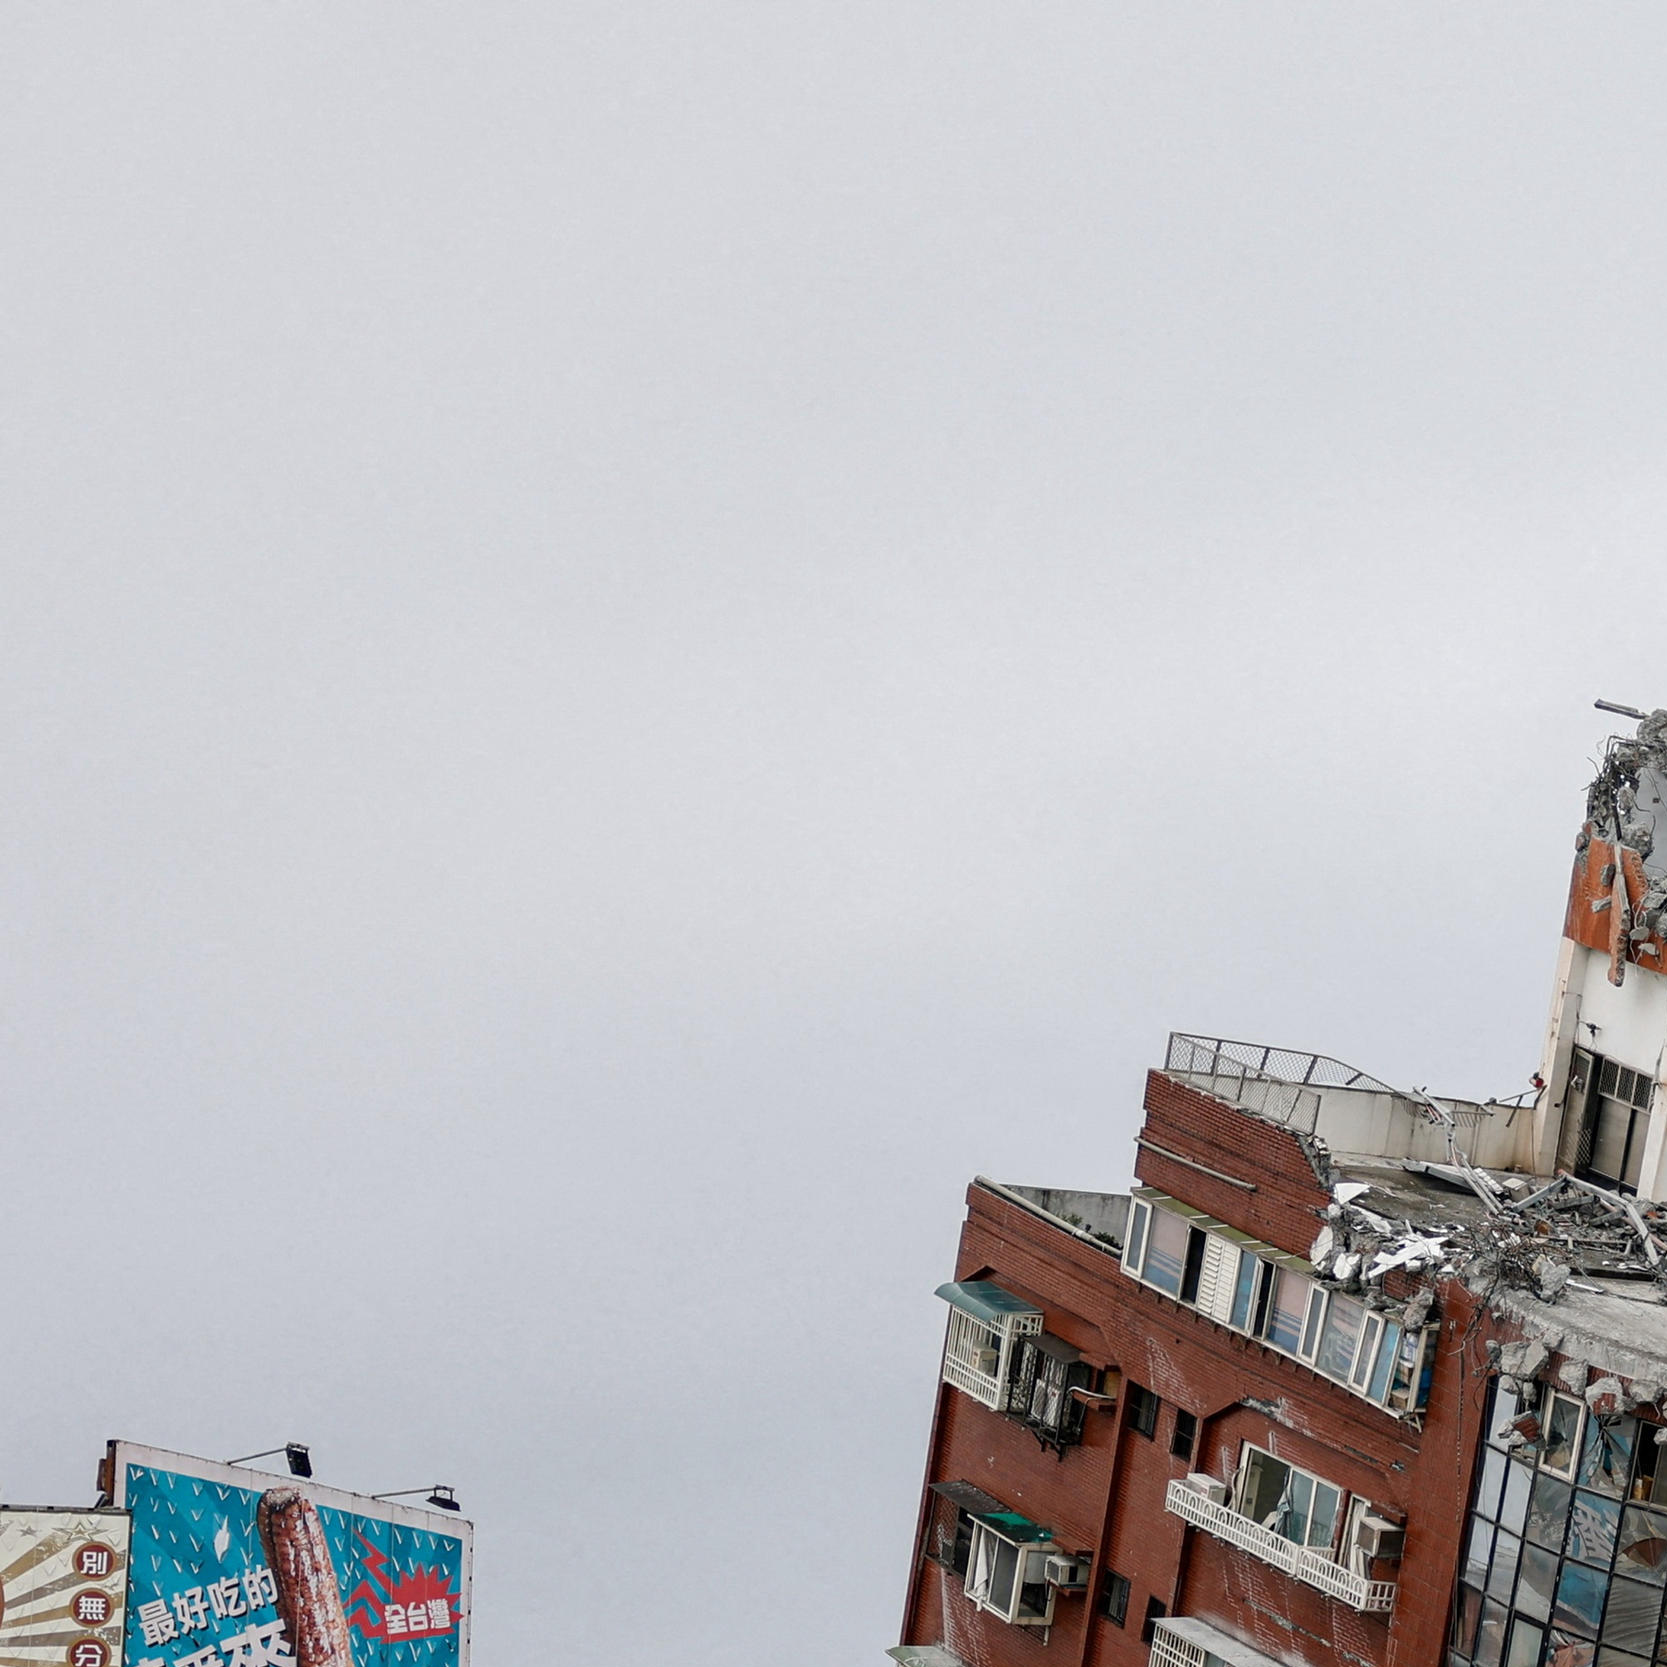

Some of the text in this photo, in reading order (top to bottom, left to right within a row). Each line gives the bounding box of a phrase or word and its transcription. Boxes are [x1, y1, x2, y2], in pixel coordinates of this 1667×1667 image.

[136, 1564, 279, 1648] 最好吃的
[383, 1598, 451, 1635] 全台灣
